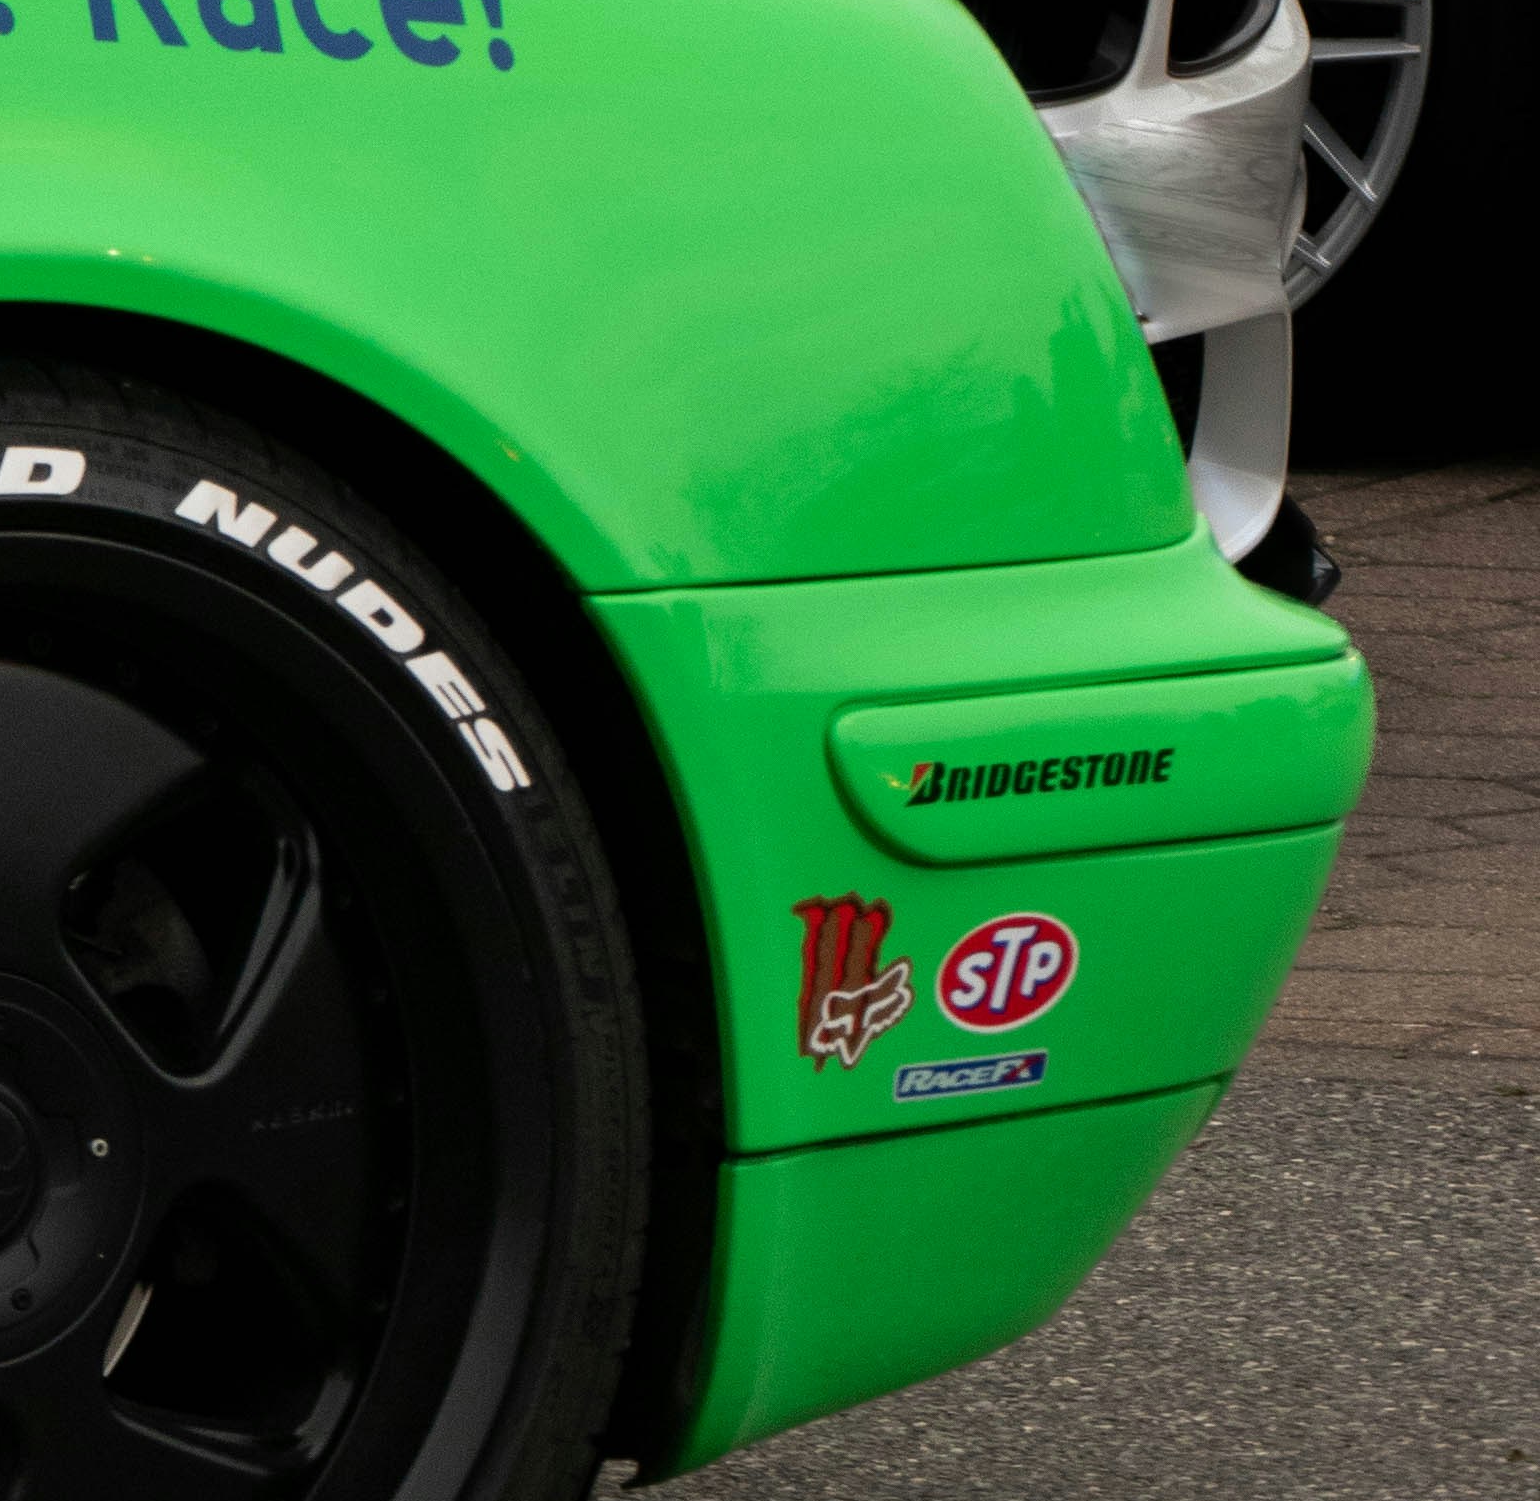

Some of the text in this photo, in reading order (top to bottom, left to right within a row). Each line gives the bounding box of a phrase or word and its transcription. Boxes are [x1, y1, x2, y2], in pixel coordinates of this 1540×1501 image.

[175, 479, 533, 793] NUDES
[906, 748, 1175, 807] BRIDGESTONE
[950, 925, 1063, 1014] STP
